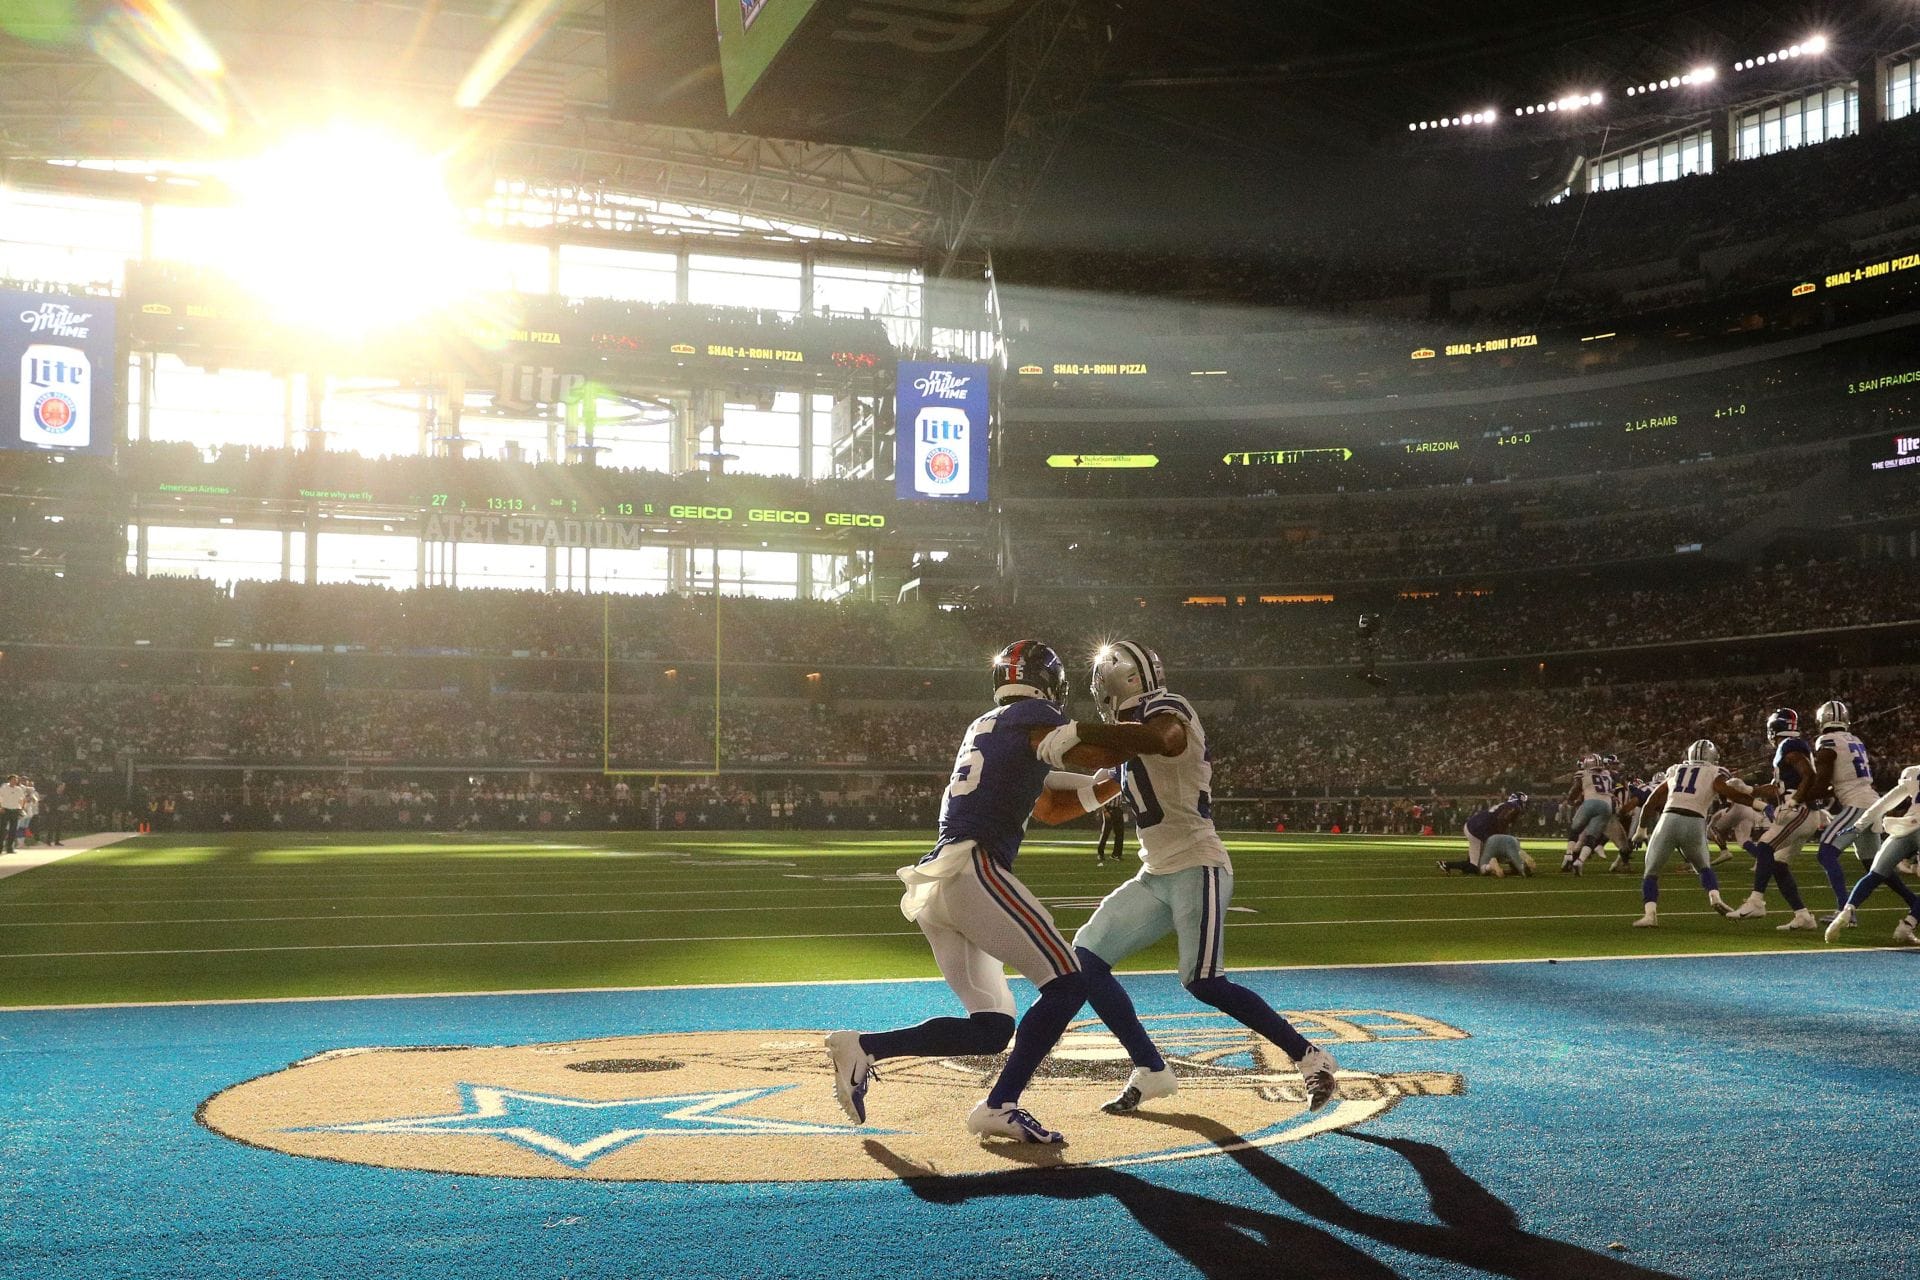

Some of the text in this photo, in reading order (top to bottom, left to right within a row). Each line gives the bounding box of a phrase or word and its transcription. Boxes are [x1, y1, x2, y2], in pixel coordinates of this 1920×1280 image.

[1825, 254, 1920, 288] SHAQ-A-RONI PIZZA
[20, 310, 92, 332] Miller
[52, 325, 90, 338] TIME
[530, 331, 561, 345] PIZZA
[1445, 338, 1509, 356] SHAQ-A-RONI
[1510, 334, 1538, 348] PIZZA
[707, 344, 774, 361] SHAQ-A-RONI
[775, 350, 804, 362] PIZZA
[29, 357, 83, 387] Lite
[929, 370, 953, 381] IT'S
[1053, 364, 1118, 375] SHAQ-A-RONI
[1119, 364, 1147, 375] PIZZA
[913, 377, 971, 397] Miller
[940, 389, 968, 399] TIME
[1848, 384, 1857, 394] 3.
[1858, 379, 1878, 392] SAN
[1625, 415, 1678, 432] 2. LA RAMS
[921, 419, 963, 445] Lite
[1405, 441, 1460, 453] 1. ARIZONA
[1897, 437, 1920, 455] Lite
[1871, 461, 1884, 470] THE
[1899, 456, 1916, 466] BEER
[159, 483, 230, 494] American Airlines
[300, 488, 316, 498] You
[330, 491, 347, 501] why
[348, 492, 361, 500] we
[361, 492, 374, 502] fly
[432, 495, 448, 506] 27
[487, 498, 523, 510] 13:13
[618, 503, 633, 515] 13
[669, 504, 733, 520] GEICO
[749, 509, 810, 524] GEICO
[825, 513, 885, 528] GEICO
[424, 512, 640, 550] AT&T STADIUM
[1004, 666, 1024, 680] 15
[1673, 766, 1701, 795] 11
